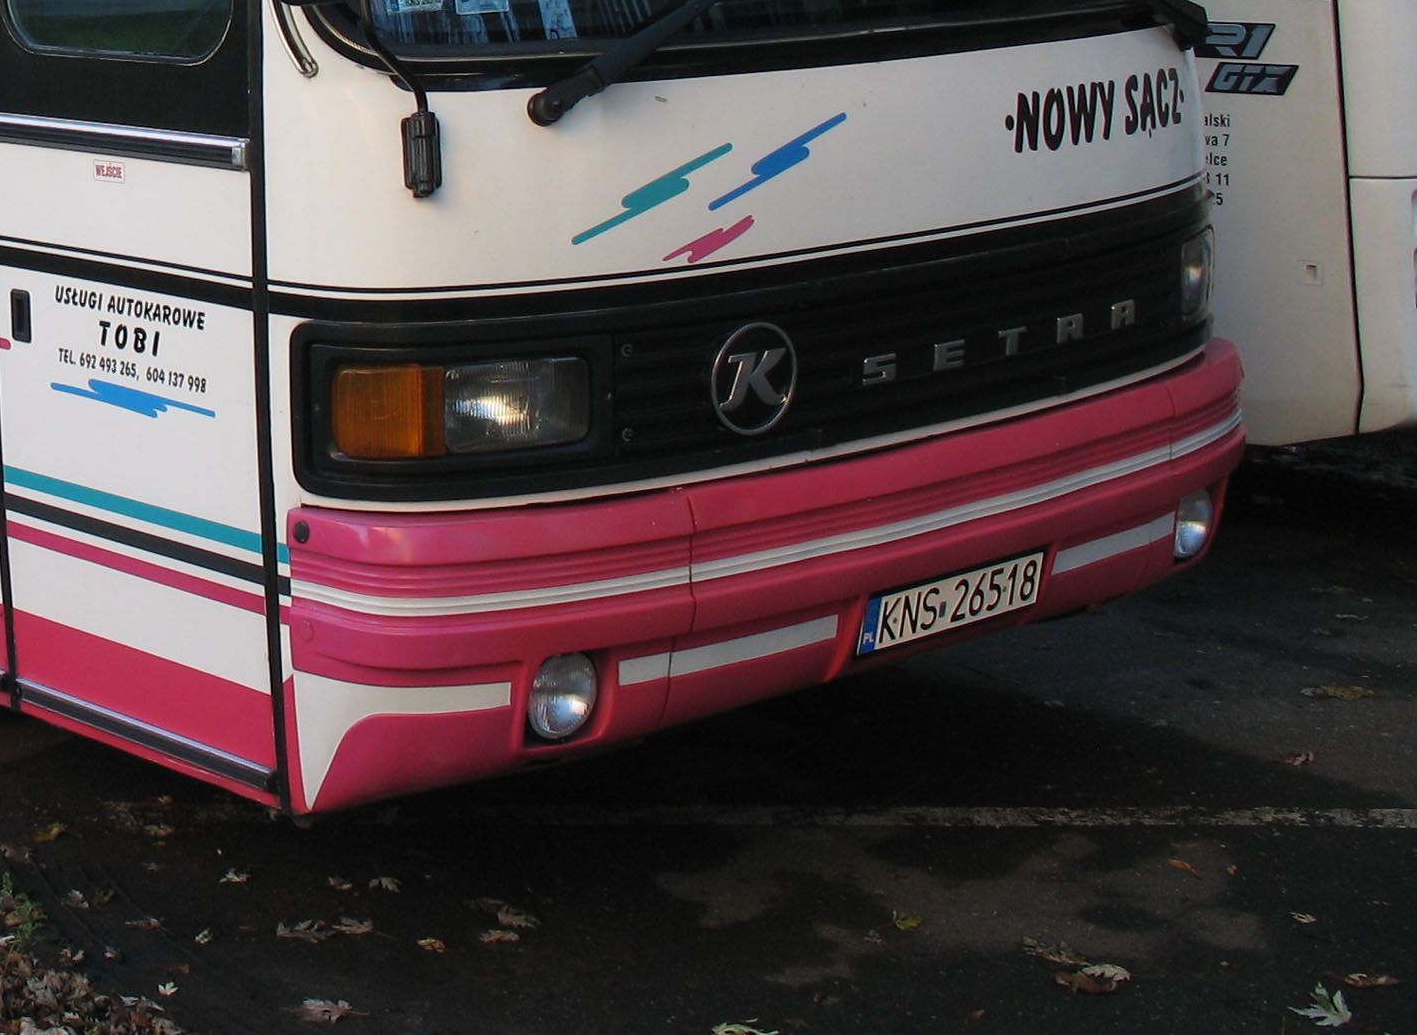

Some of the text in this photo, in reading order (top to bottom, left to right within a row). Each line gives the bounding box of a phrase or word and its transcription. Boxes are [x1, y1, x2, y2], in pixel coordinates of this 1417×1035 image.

[55, 285, 206, 330] USŁUGI AUTOKAROWE
[99, 320, 160, 357] TOBI
[862, 299, 1135, 386] SETRA
[58, 348, 76, 365] TEL.
[79, 352, 97, 369] 692
[99, 357, 117, 373] 493
[146, 366, 165, 384] 604
[168, 371, 185, 388] 137
[187, 374, 207, 393] 998
[878, 560, 1038, 644] KNS 26518
